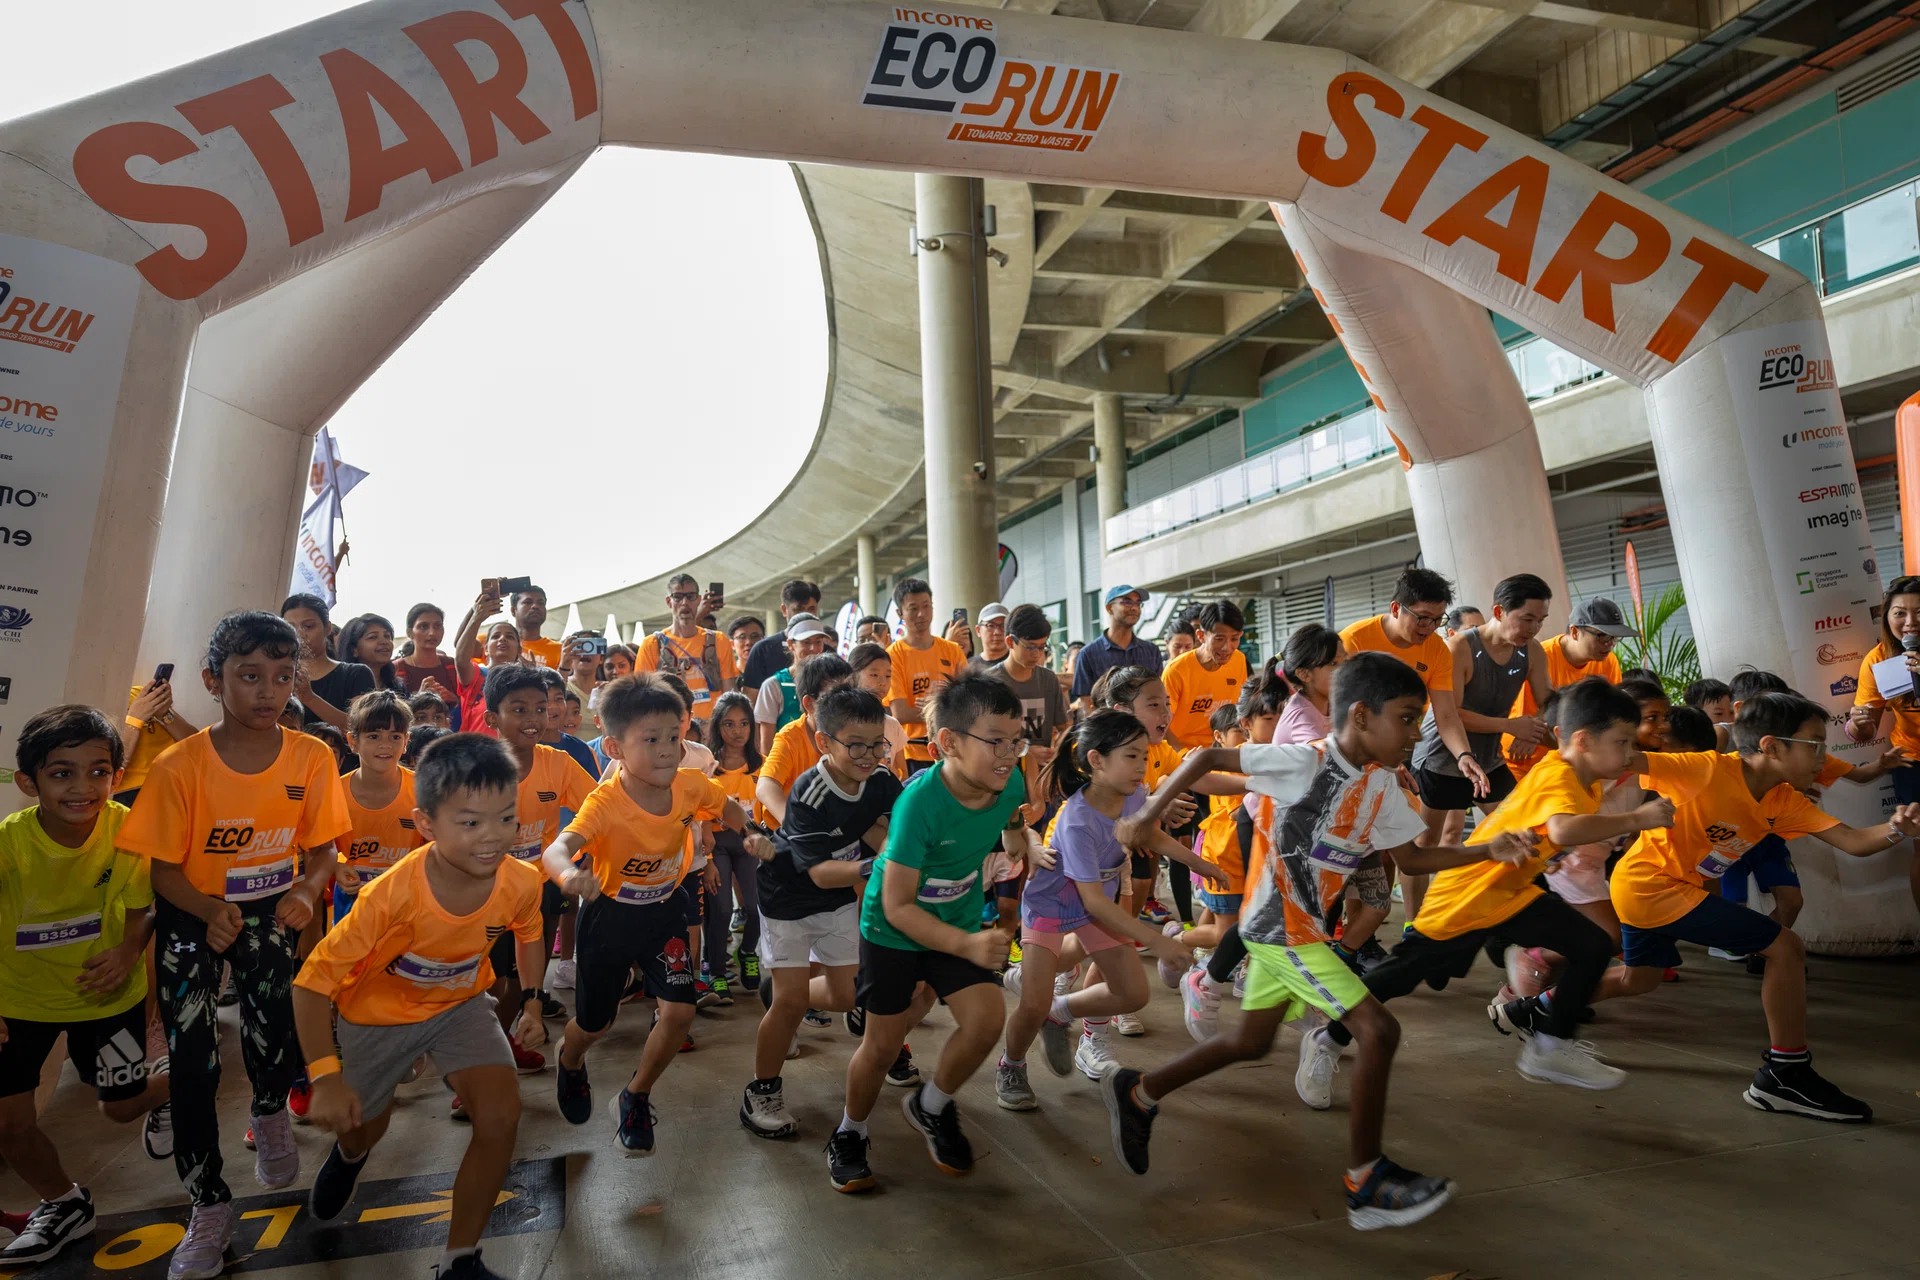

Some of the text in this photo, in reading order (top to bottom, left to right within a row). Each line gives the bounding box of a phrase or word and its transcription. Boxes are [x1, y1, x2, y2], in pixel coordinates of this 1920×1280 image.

[895, 8, 993, 31] income
[870, 25, 997, 94] ECO
[960, 61, 1120, 131] RUN
[967, 128, 1074, 147] TOWARDS ZERO WASTE
[73, 0, 598, 300] START
[1297, 72, 1770, 364] START
[0, 296, 95, 342] RUN
[19, 334, 37, 343] ZERO
[38, 338, 61, 348] WASTE
[1764, 344, 1801, 357] income
[0, 366, 20, 375] WNER
[1760, 353, 1804, 383] ECO
[1797, 359, 1834, 384] RUN
[0, 396, 58, 421] ome
[16, 421, 54, 437] yours
[1800, 425, 1844, 441] income
[1800, 554, 1819, 562] CHARITY
[1814, 569, 1841, 577] Singapore
[1815, 573, 1848, 583] Environment
[7, 585, 38, 595] PARTNER
[1817, 581, 1837, 589] Council
[1815, 615, 1851, 630] ntuc
[4, 630, 21, 638] CHI
[913, 677, 930, 691] ECO
[1191, 698, 1213, 710] ECO
[215, 817, 255, 827] income
[206, 826, 297, 852] ECO RUN
[1705, 825, 1737, 841] ECO
[349, 841, 379, 856] ECO
[622, 858, 662, 873] ECO
[246, 874, 279, 890] B372
[634, 890, 662, 898] B333
[39, 927, 79, 941] B356
